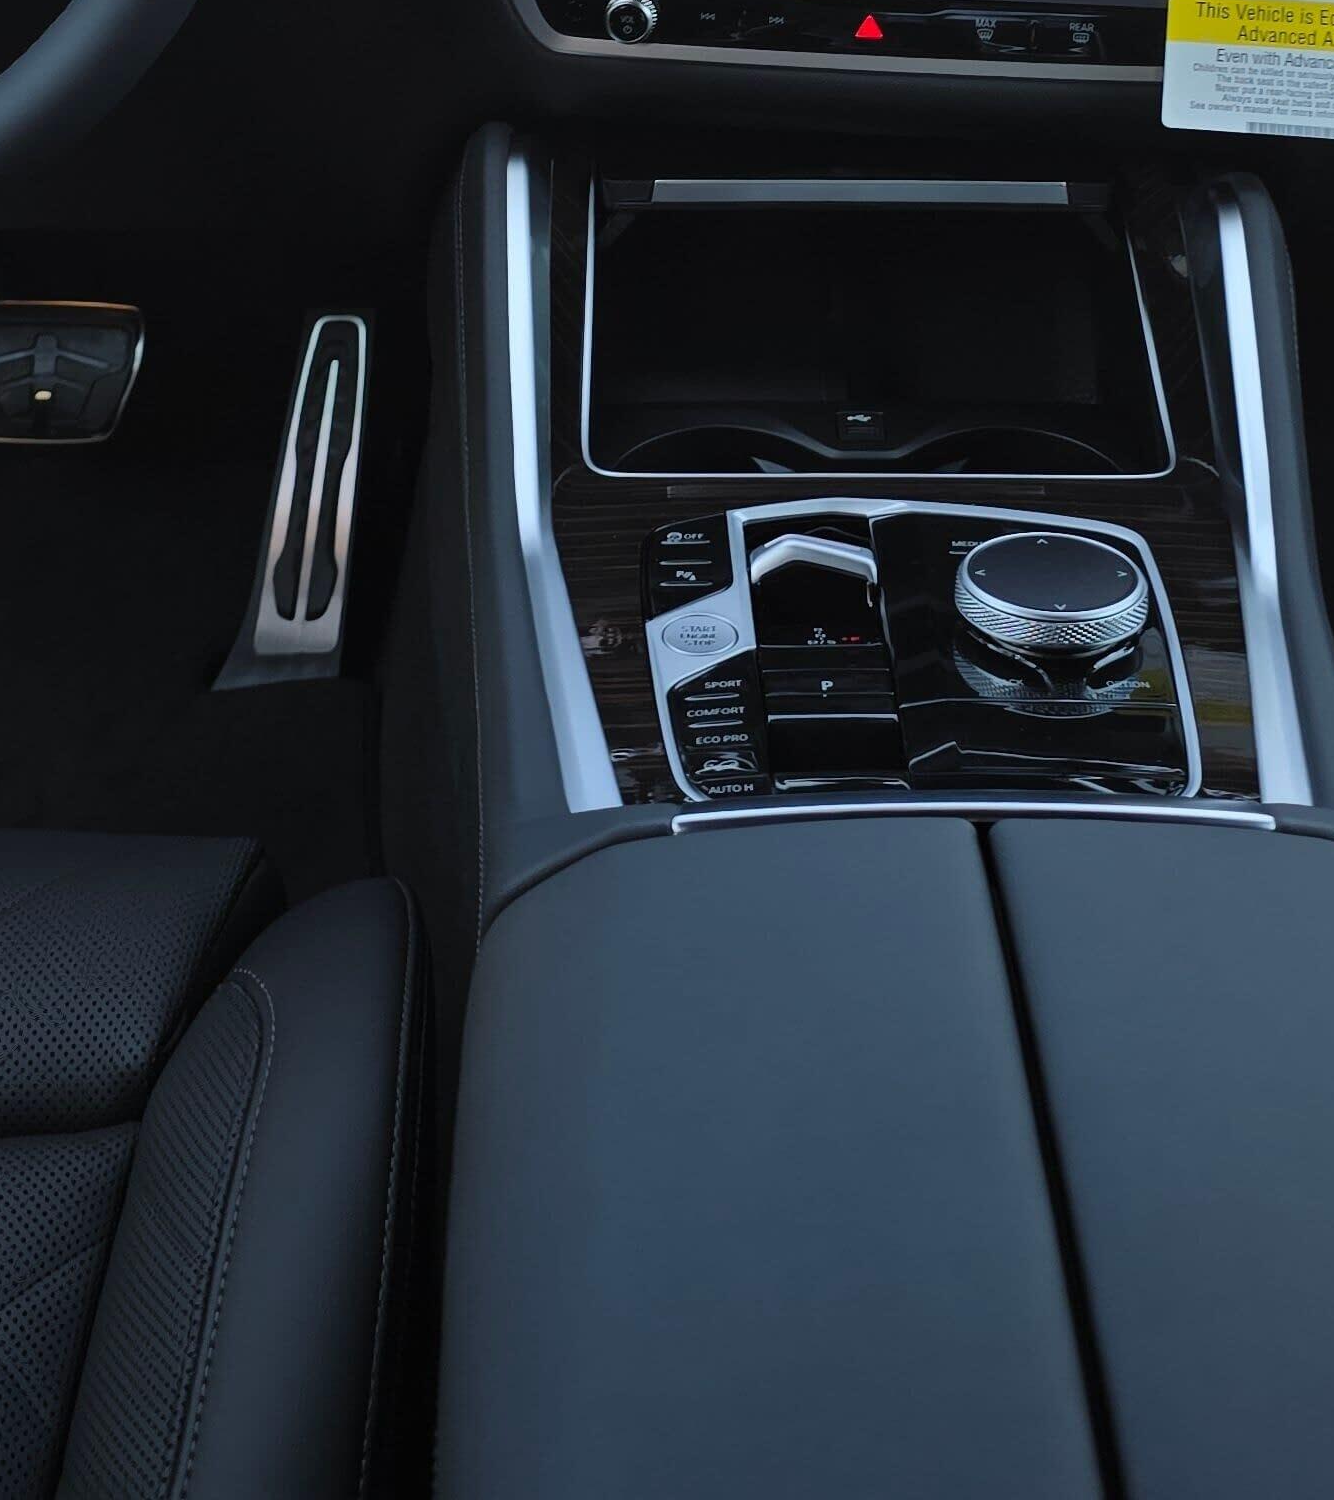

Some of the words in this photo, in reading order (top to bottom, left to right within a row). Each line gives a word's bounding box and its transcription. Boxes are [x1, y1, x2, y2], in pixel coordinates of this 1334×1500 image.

[1196, 1, 1230, 19] This
[1235, 4, 1294, 23] Vehicle
[1300, 8, 1313, 24] is
[975, 17, 997, 28] MAX
[1069, 23, 1095, 33] REAR
[1237, 25, 1317, 46] Advanced
[1216, 48, 1248, 64] Even
[1252, 51, 1281, 66] with
[1216, 74, 1232, 83] The
[704, 679, 743, 690] SPORT
[820, 679, 835, 692] P
[686, 706, 746, 718] COMFORT
[695, 735, 721, 745] ECO
[722, 733, 749, 743] PRO
[708, 784, 742, 795] AUTO
[743, 783, 754, 792] H
